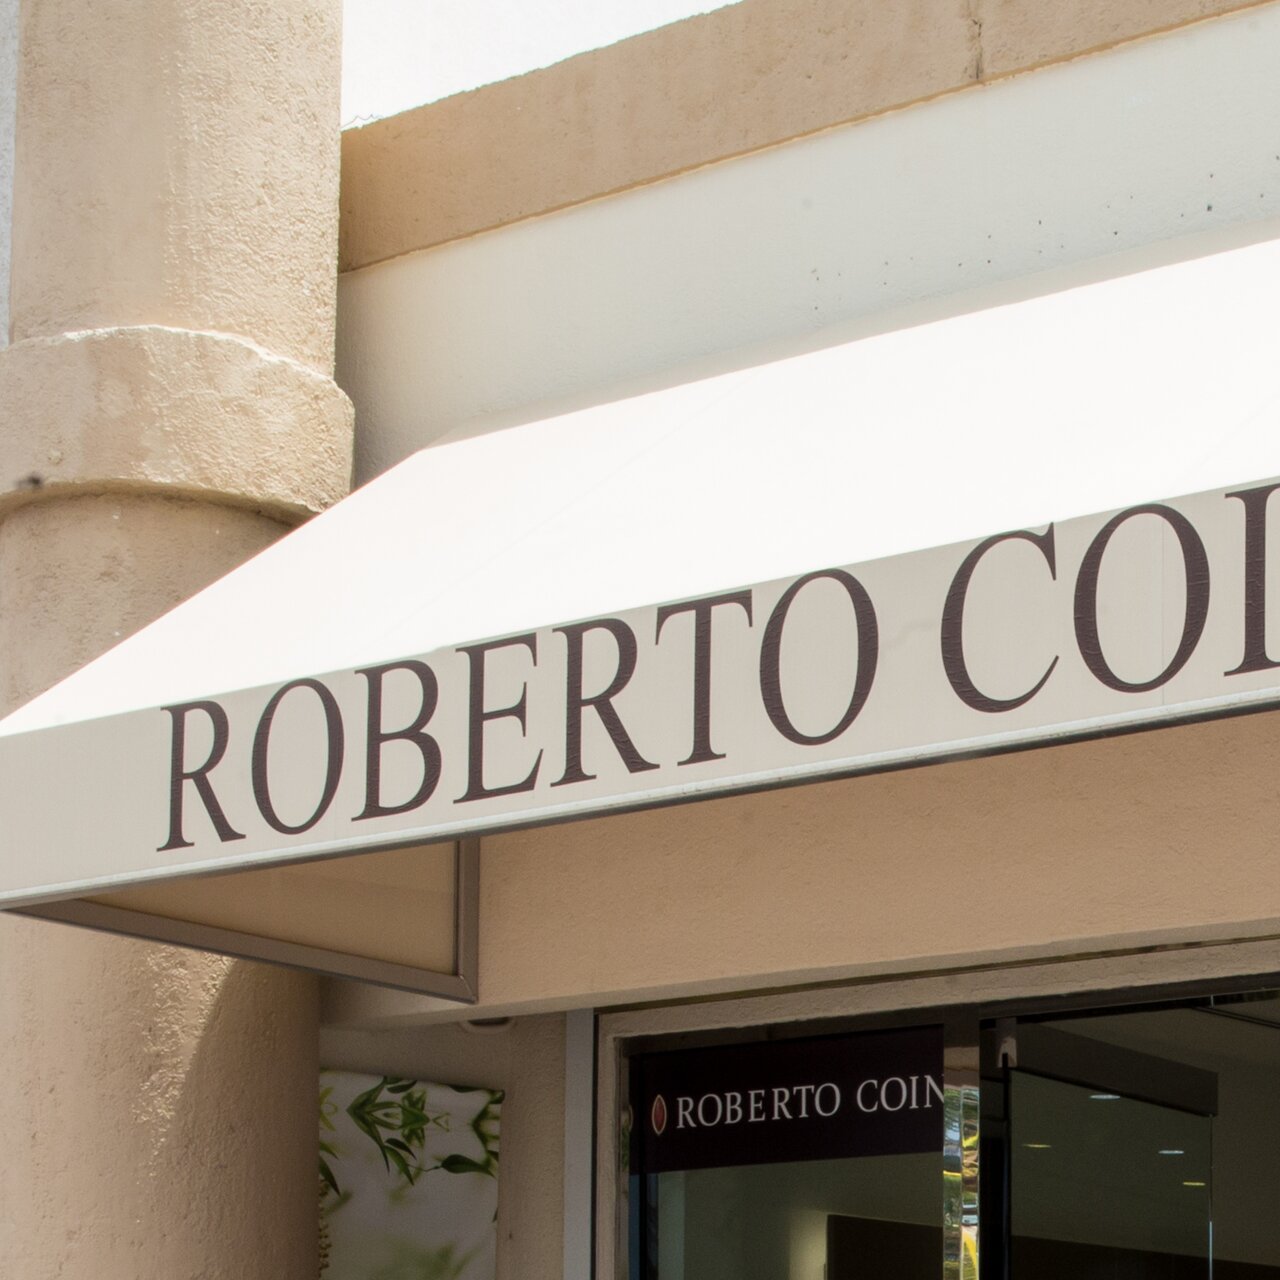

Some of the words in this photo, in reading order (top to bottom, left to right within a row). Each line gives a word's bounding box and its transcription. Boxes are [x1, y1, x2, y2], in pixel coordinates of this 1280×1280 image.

[156, 567, 879, 852] ROBERTO
[676, 1083, 841, 1128] ROBERTO
[856, 1075, 944, 1112] COIN
